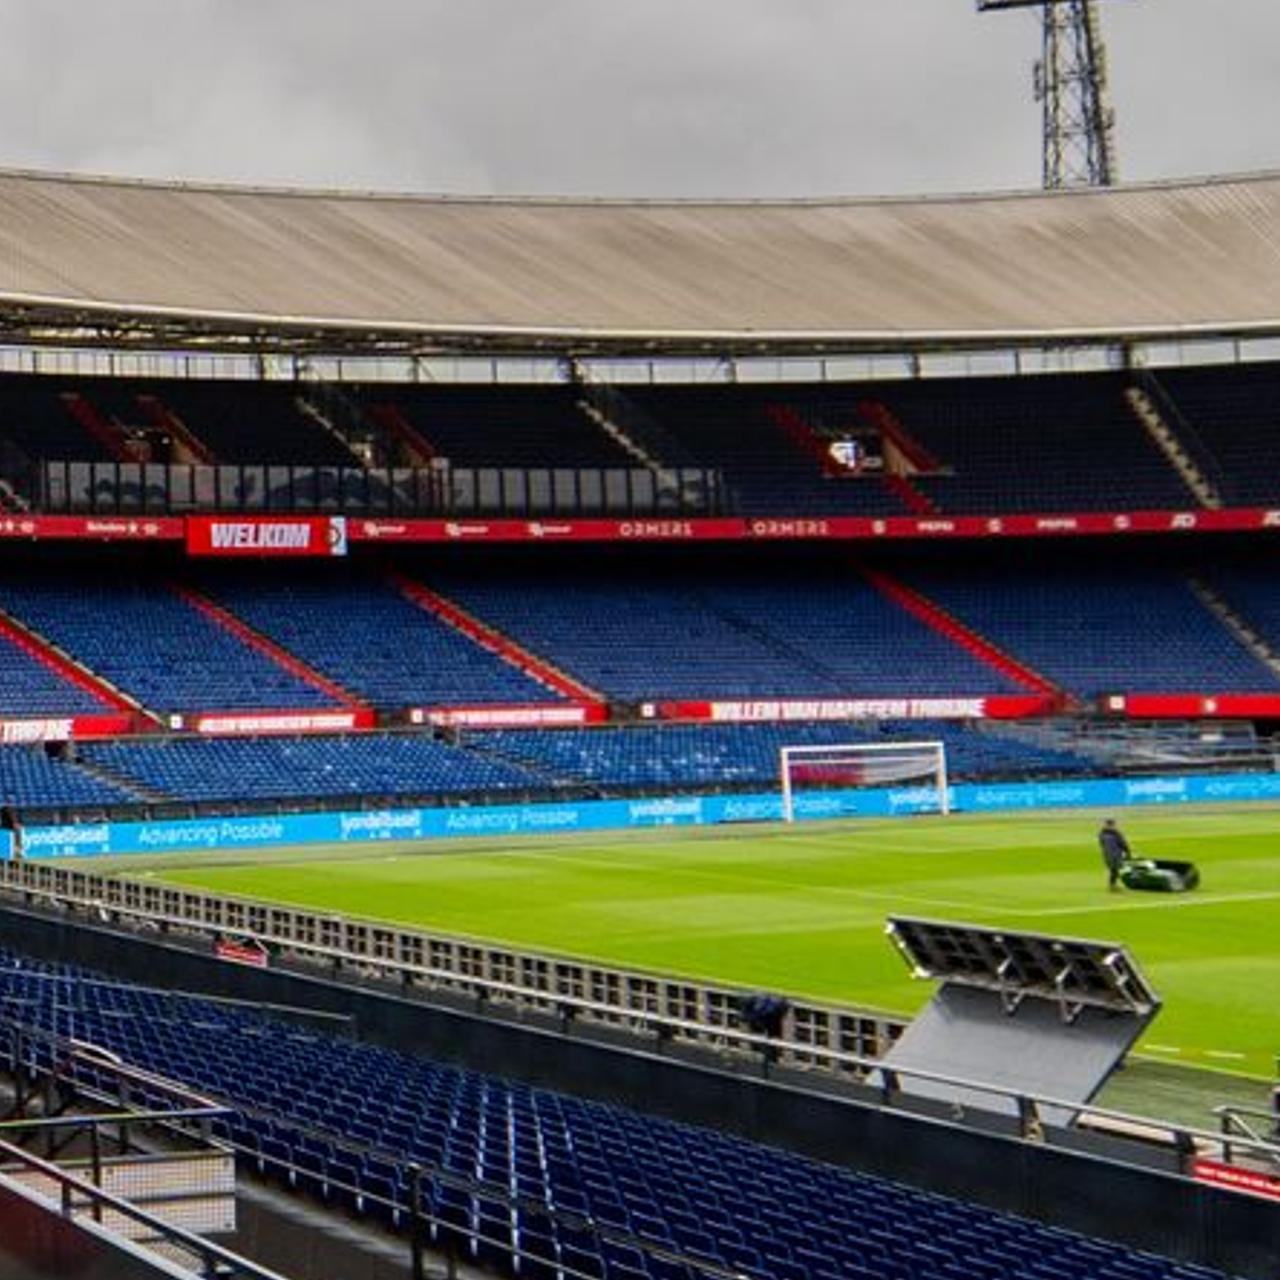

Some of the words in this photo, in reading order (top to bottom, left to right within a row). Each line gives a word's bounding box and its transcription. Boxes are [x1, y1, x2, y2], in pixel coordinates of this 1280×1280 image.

[210, 523, 311, 548] WELKOM
[139, 824, 218, 847] Advancing
[220, 820, 284, 839] Possible
